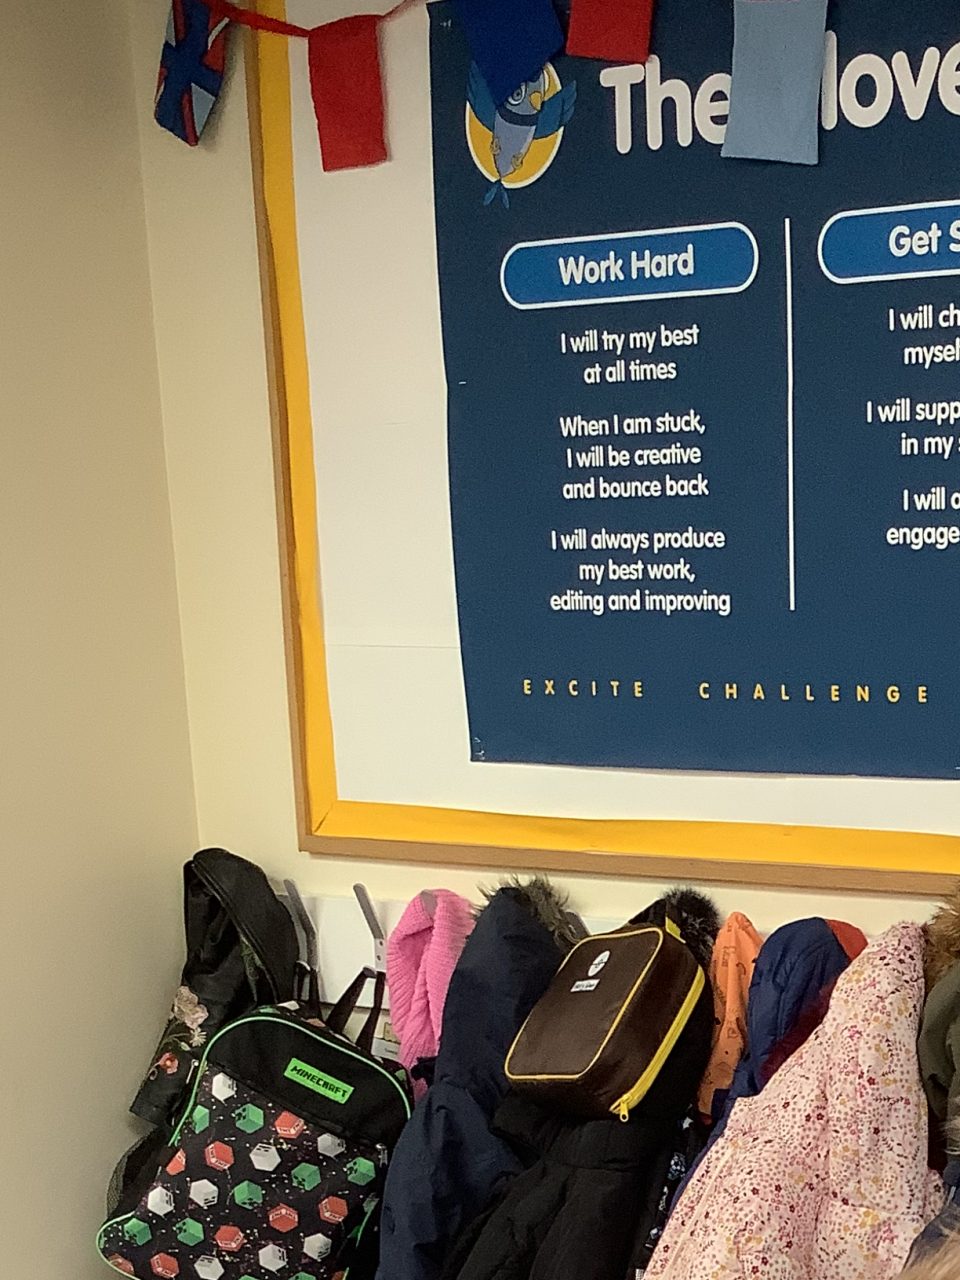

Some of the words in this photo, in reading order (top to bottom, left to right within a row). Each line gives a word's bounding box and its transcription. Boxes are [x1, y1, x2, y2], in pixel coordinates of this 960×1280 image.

[599, 54, 733, 154] The
[888, 222, 942, 257] Get
[558, 250, 625, 286] Work
[630, 243, 695, 280] Hard
[888, 308, 895, 331] I
[899, 304, 933, 330] will
[560, 332, 567, 354] I
[569, 328, 599, 353] will
[601, 330, 626, 356] try
[629, 330, 657, 354] my
[660, 323, 700, 347] best
[583, 362, 602, 384] at
[605, 359, 626, 383] all
[628, 358, 677, 381] times
[559, 414, 610, 438] When
[613, 414, 619, 435] I
[622, 416, 652, 435] am
[655, 408, 706, 435] stuck,
[866, 400, 873, 423] I
[877, 397, 911, 423] will
[566, 447, 573, 469] I
[575, 445, 604, 468] will
[607, 444, 631, 467] be
[633, 442, 702, 466] creative
[901, 432, 919, 456] in
[923, 435, 954, 460] my
[562, 476, 596, 500] and
[598, 476, 662, 499] bounce
[665, 472, 710, 497] back
[903, 489, 909, 511] I
[913, 486, 946, 511] will
[551, 530, 557, 550] I
[560, 528, 587, 550] will
[590, 527, 650, 555] always
[653, 525, 726, 554] produce
[886, 526, 960, 550] engage
[578, 564, 605, 586] my
[608, 558, 645, 581] best
[646, 557, 696, 583] work,
[549, 589, 605, 616] editing
[607, 588, 641, 611] and
[644, 589, 731, 616] improving
[523, 679, 643, 698] EXCITE
[699, 682, 927, 703] CHALLENGE
[290, 1065, 348, 1098] MINECRAFT
